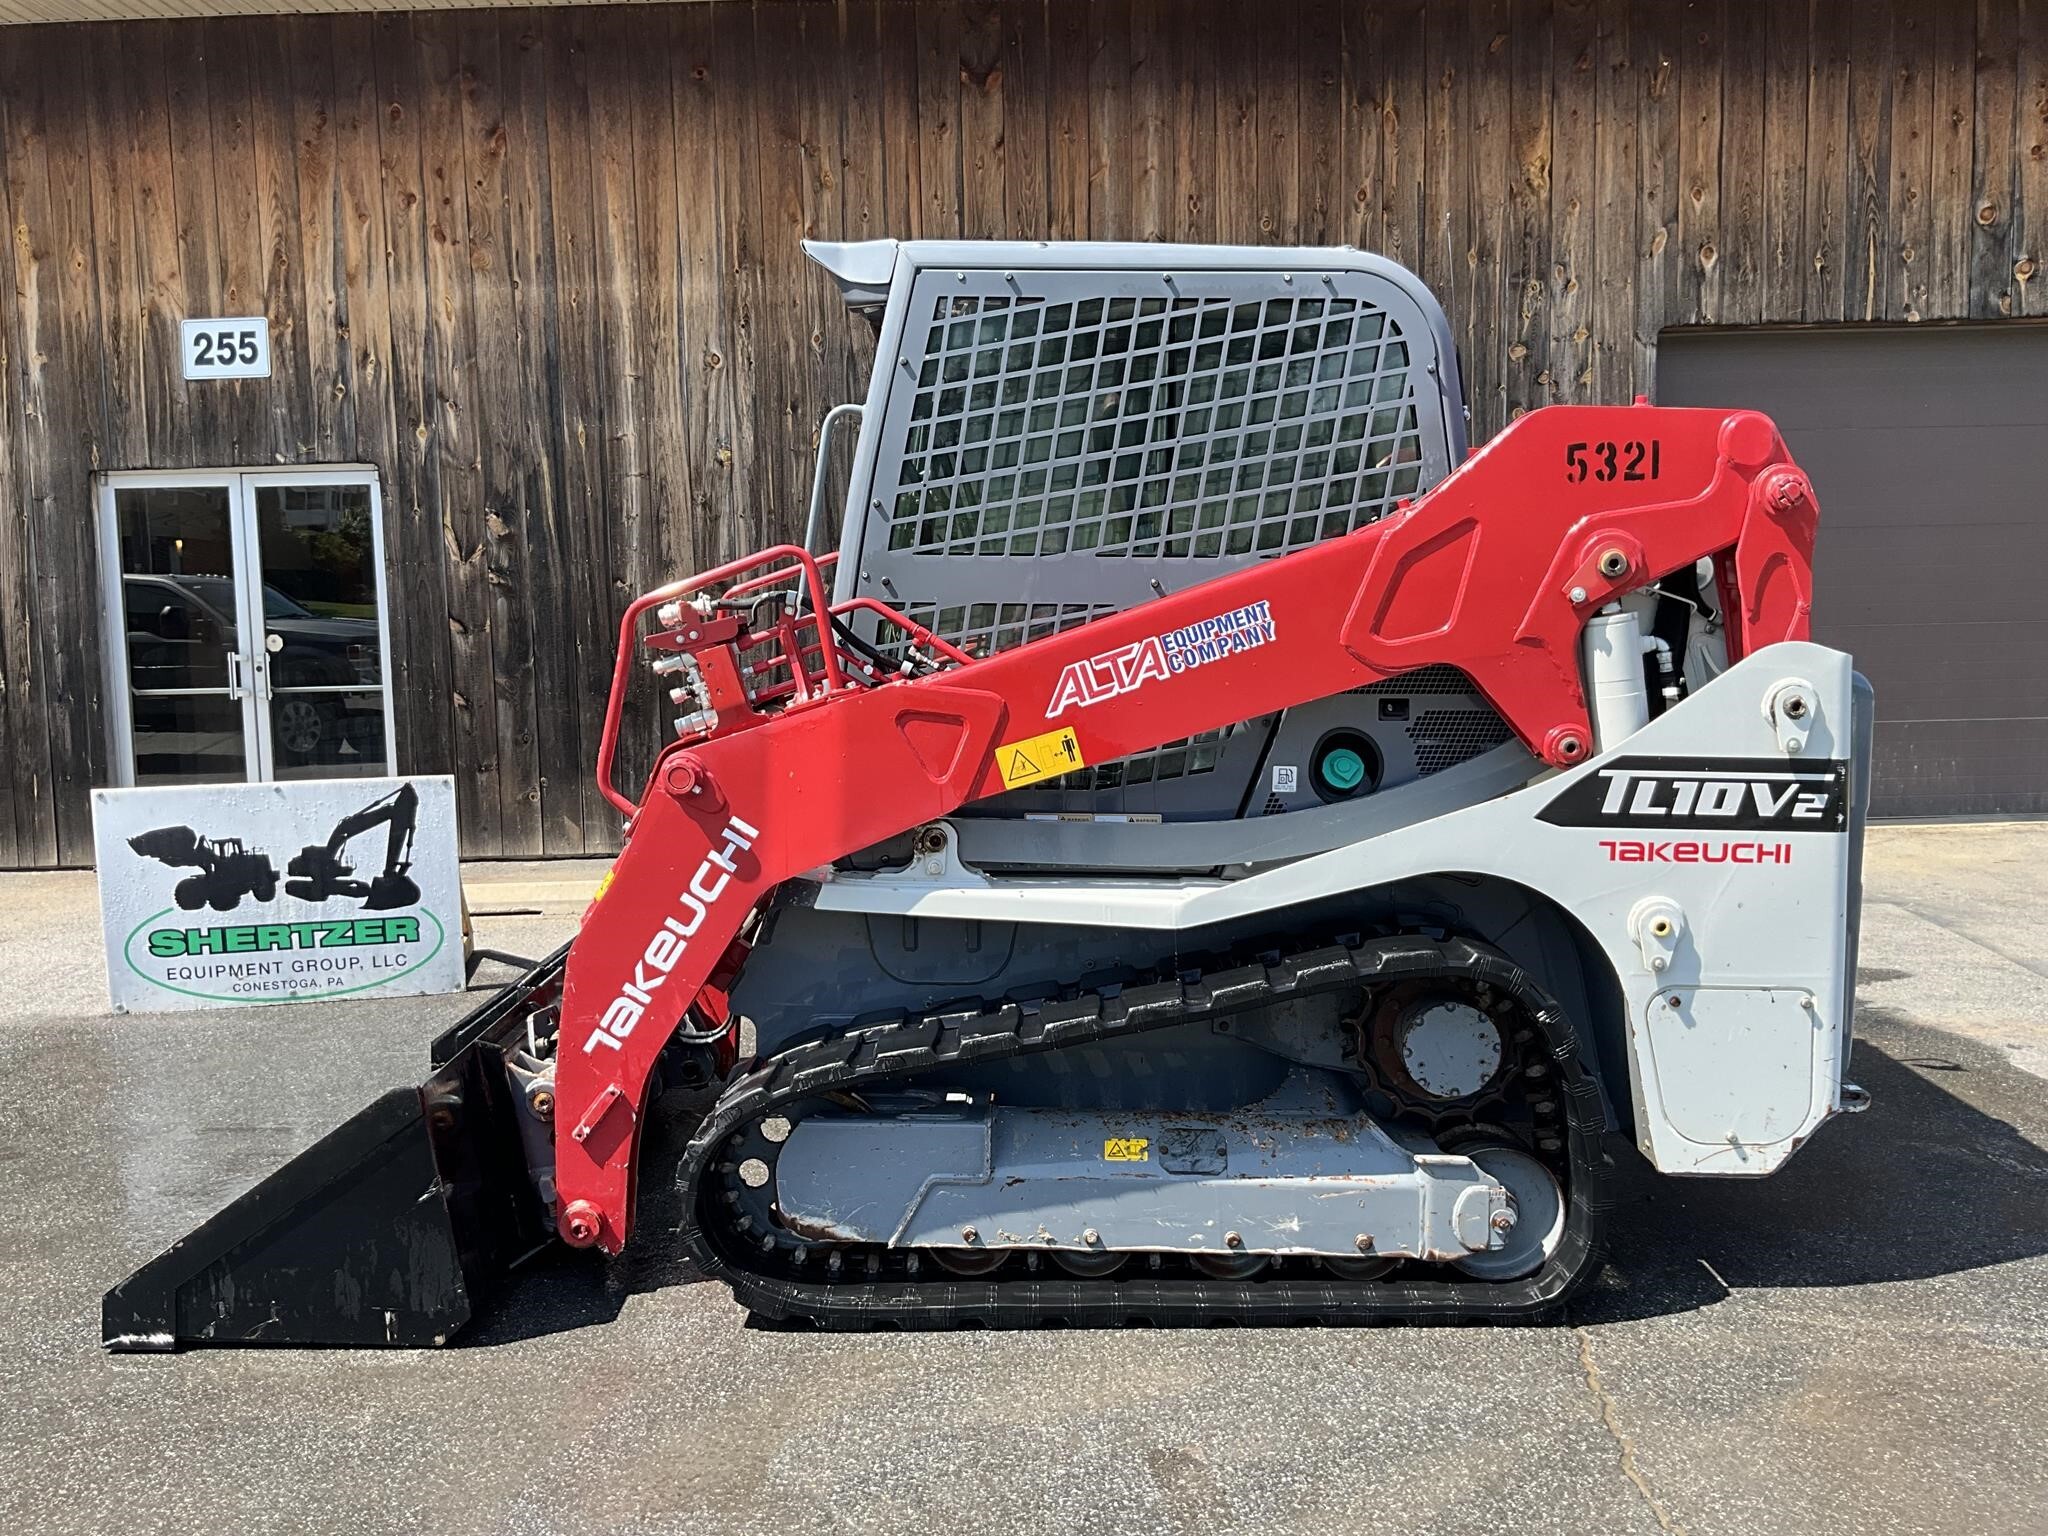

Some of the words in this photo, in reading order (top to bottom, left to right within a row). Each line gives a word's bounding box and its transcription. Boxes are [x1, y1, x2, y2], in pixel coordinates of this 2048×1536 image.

[193, 331, 258, 366] 255
[1567, 440, 1660, 483] 5321
[1160, 600, 1271, 654] EQUIPMENT
[1167, 620, 1277, 674] COMPANY
[1045, 637, 1171, 719] ALTA
[1598, 769, 1836, 818] TL10V2
[1599, 841, 1792, 864] TAKEUCHI
[148, 916, 420, 957] SHERTZER
[582, 815, 760, 1054] TAKEUCHI
[166, 961, 283, 981] EQUIPMENT
[291, 957, 364, 974] GROUP,
[372, 953, 408, 968] LLC
[232, 978, 323, 993] CONESTOGA,
[327, 977, 345, 987] PA
